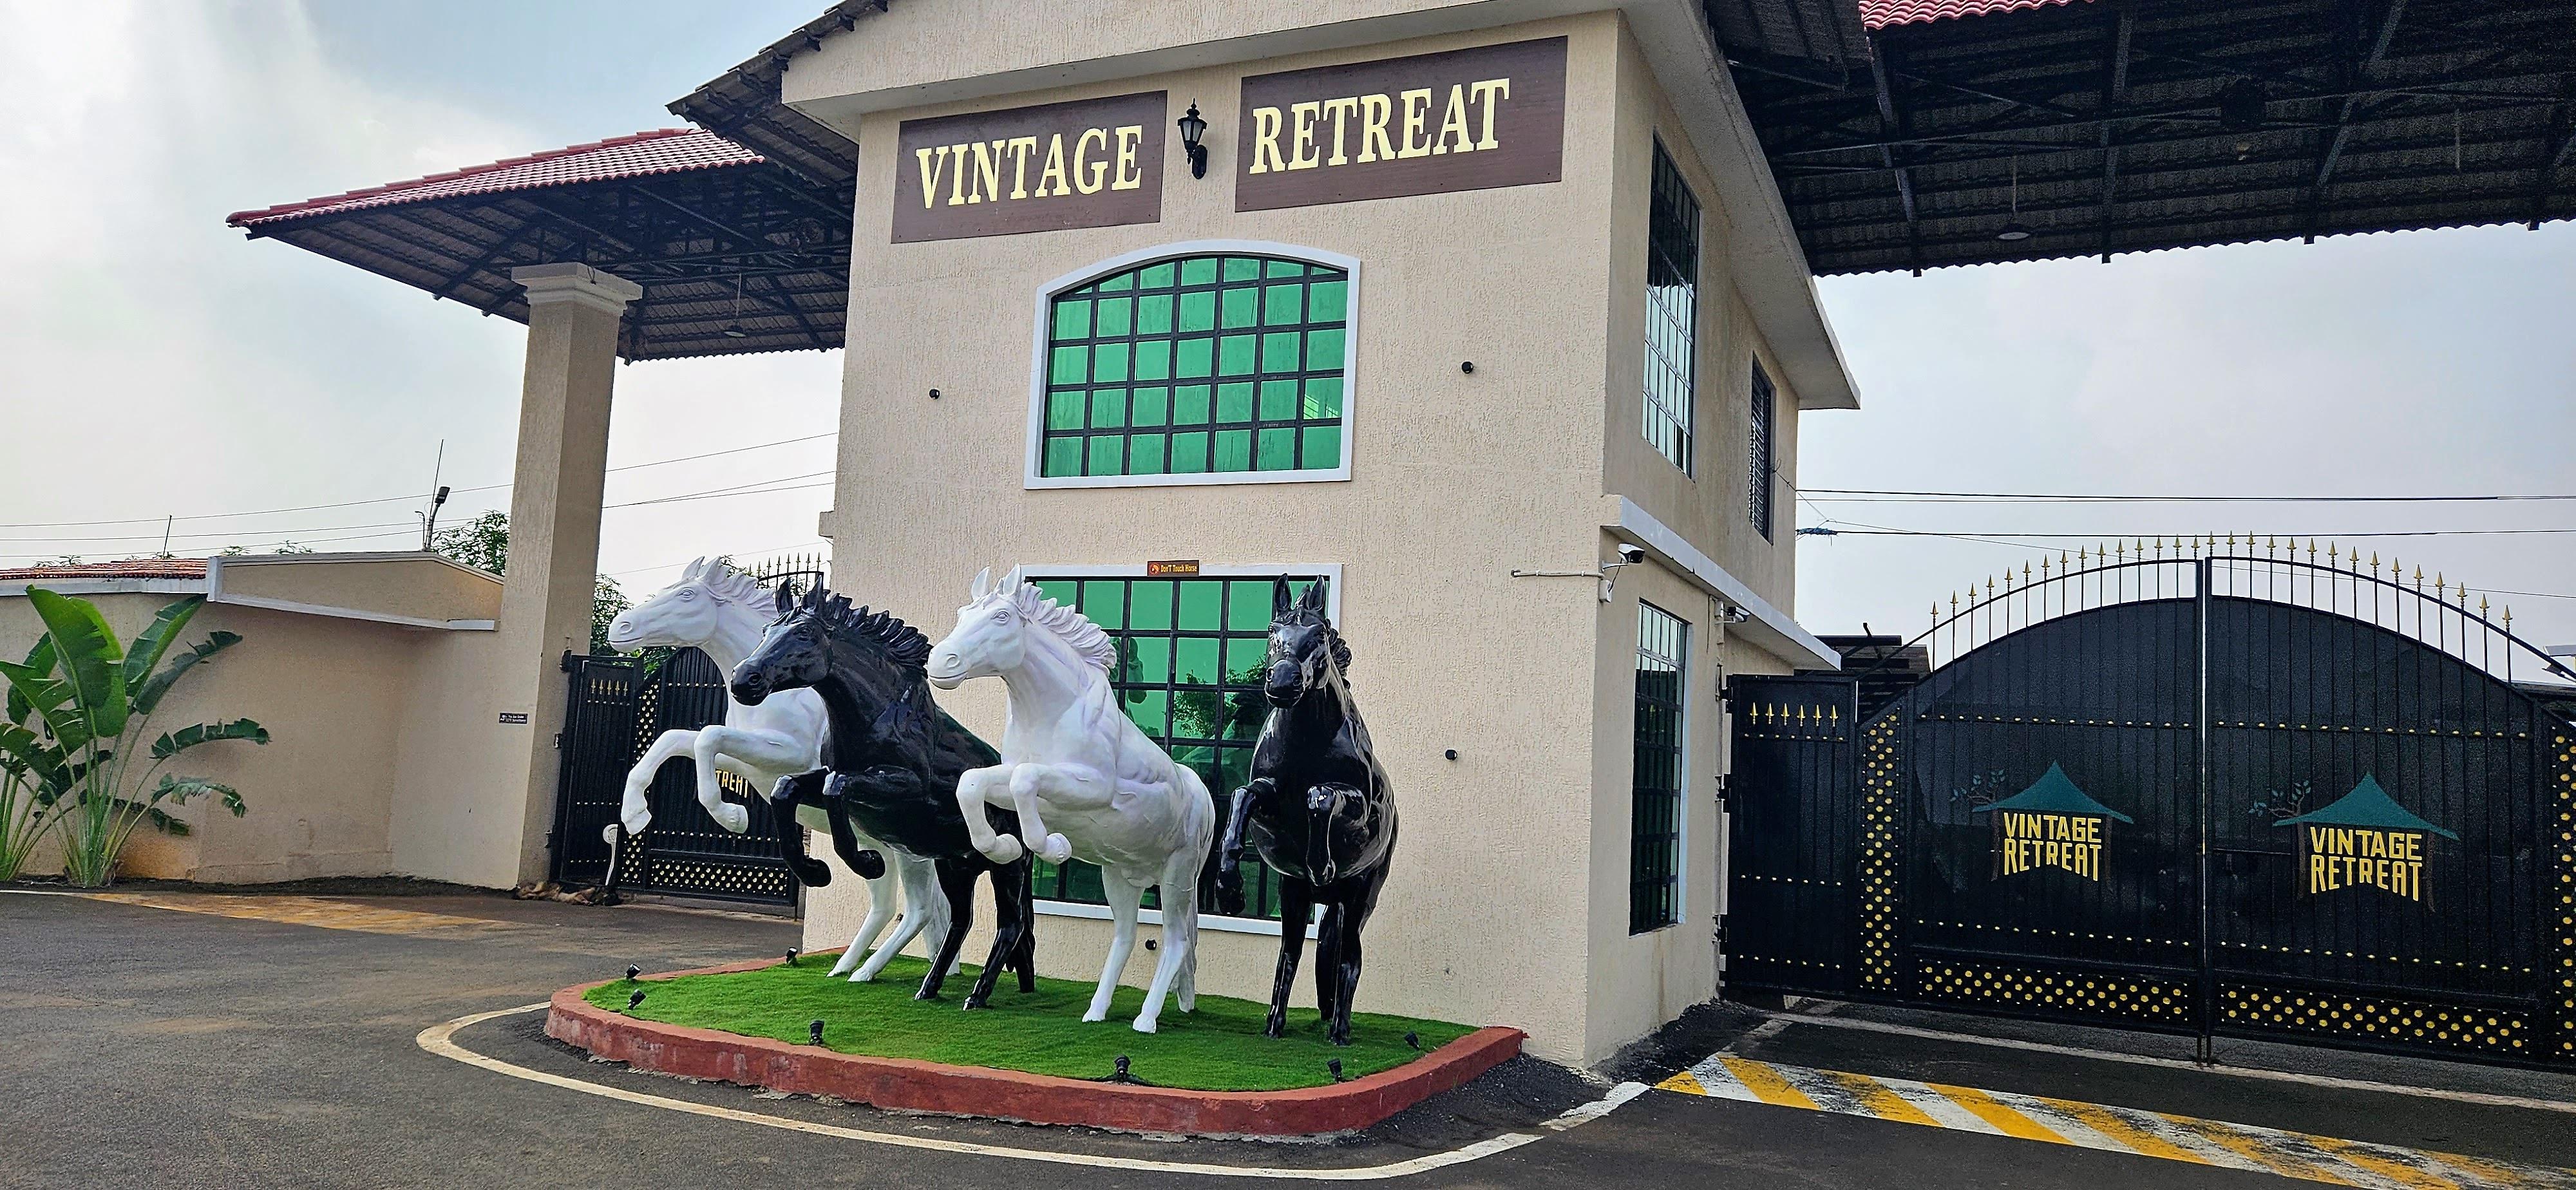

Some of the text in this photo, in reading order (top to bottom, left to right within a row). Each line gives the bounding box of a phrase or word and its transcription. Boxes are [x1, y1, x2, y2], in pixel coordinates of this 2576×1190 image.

[916, 78, 1510, 209] VINTAGE RETREAT
[1173, 564, 1184, 572] Touch
[1185, 563, 1197, 572] Horse
[715, 770, 748, 798] TREAT
[2003, 812, 2102, 844] VINTAGE
[2310, 826, 2423, 861] VINTAGE
[2004, 838, 2102, 882] RETREAT
[2311, 854, 2423, 902] RETREAT
